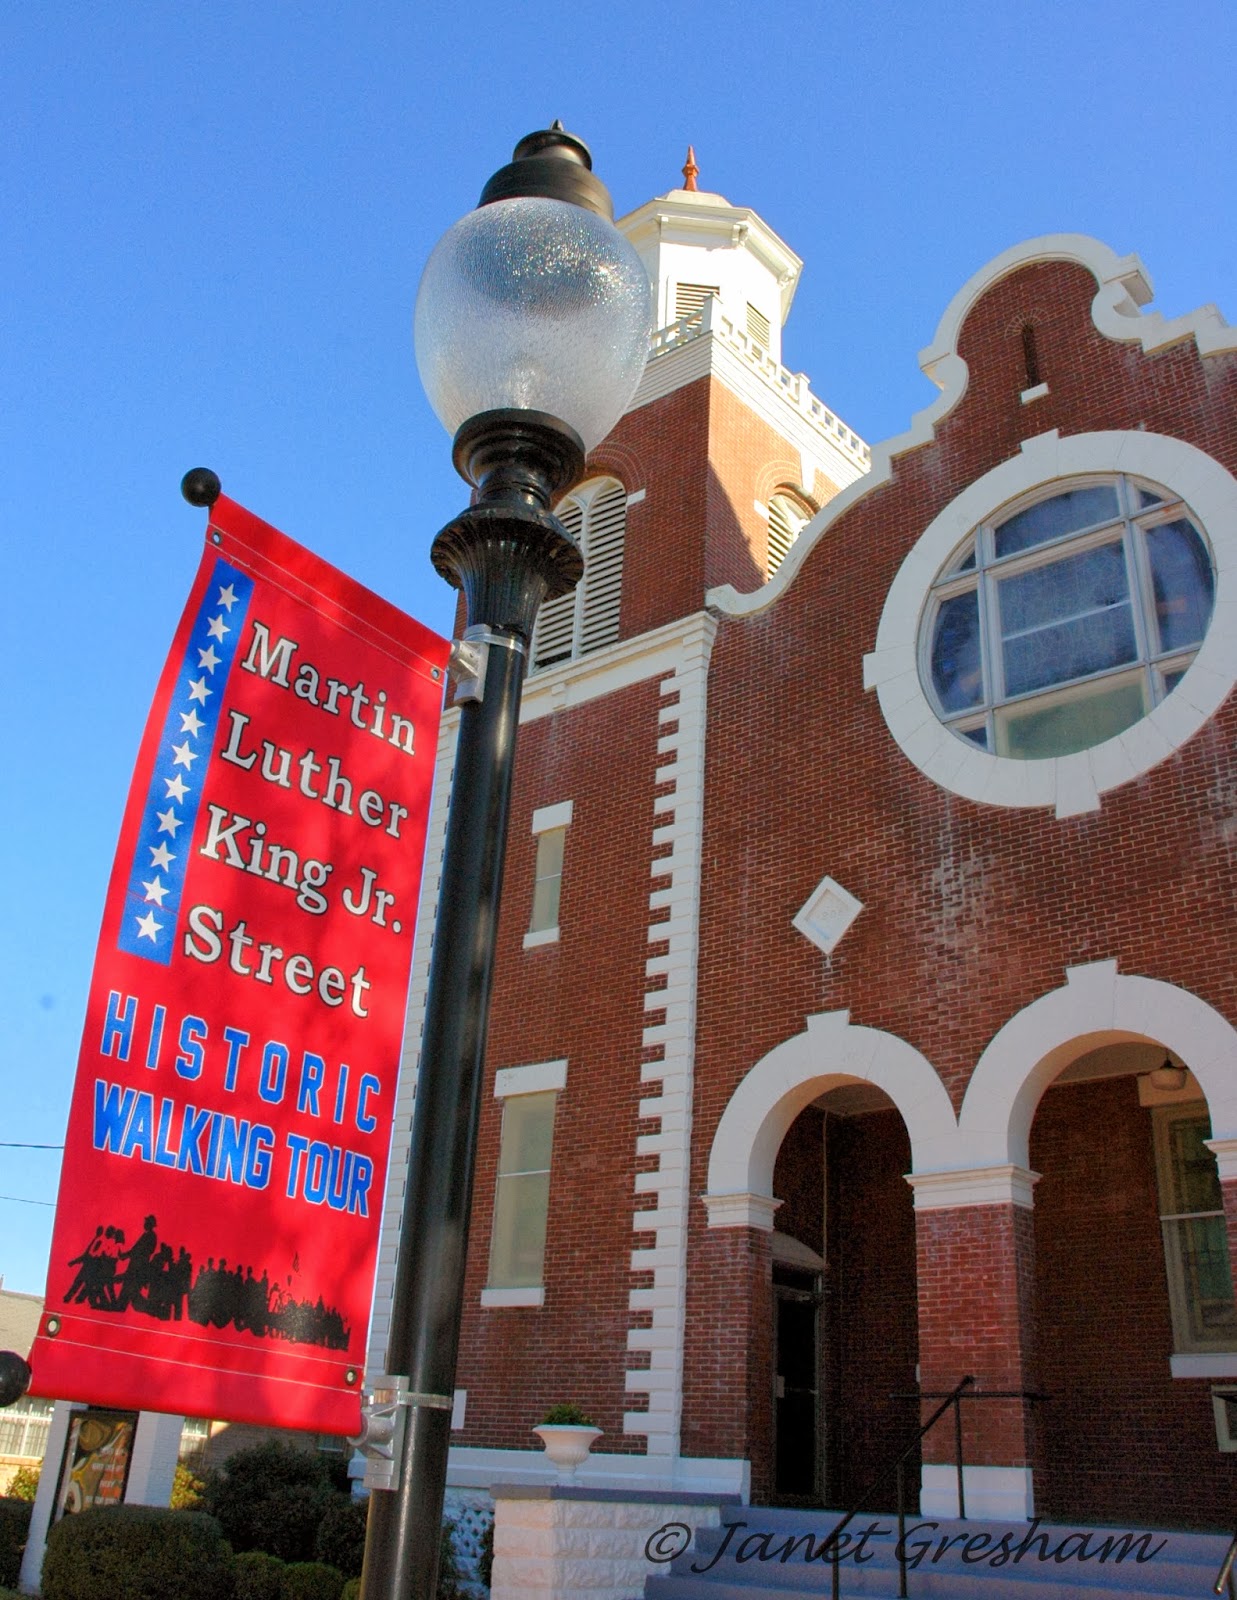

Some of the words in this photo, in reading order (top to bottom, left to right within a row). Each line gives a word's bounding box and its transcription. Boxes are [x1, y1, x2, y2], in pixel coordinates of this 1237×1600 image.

[241, 621, 416, 756] Martin
[221, 711, 408, 838] Luther
[200, 804, 333, 914] King
[342, 867, 402, 934] Jr.
[184, 906, 371, 1018] Street
[100, 991, 381, 1134] HISTORIC
[93, 1079, 275, 1190] WALKING
[286, 1133, 374, 1218] TOUR
